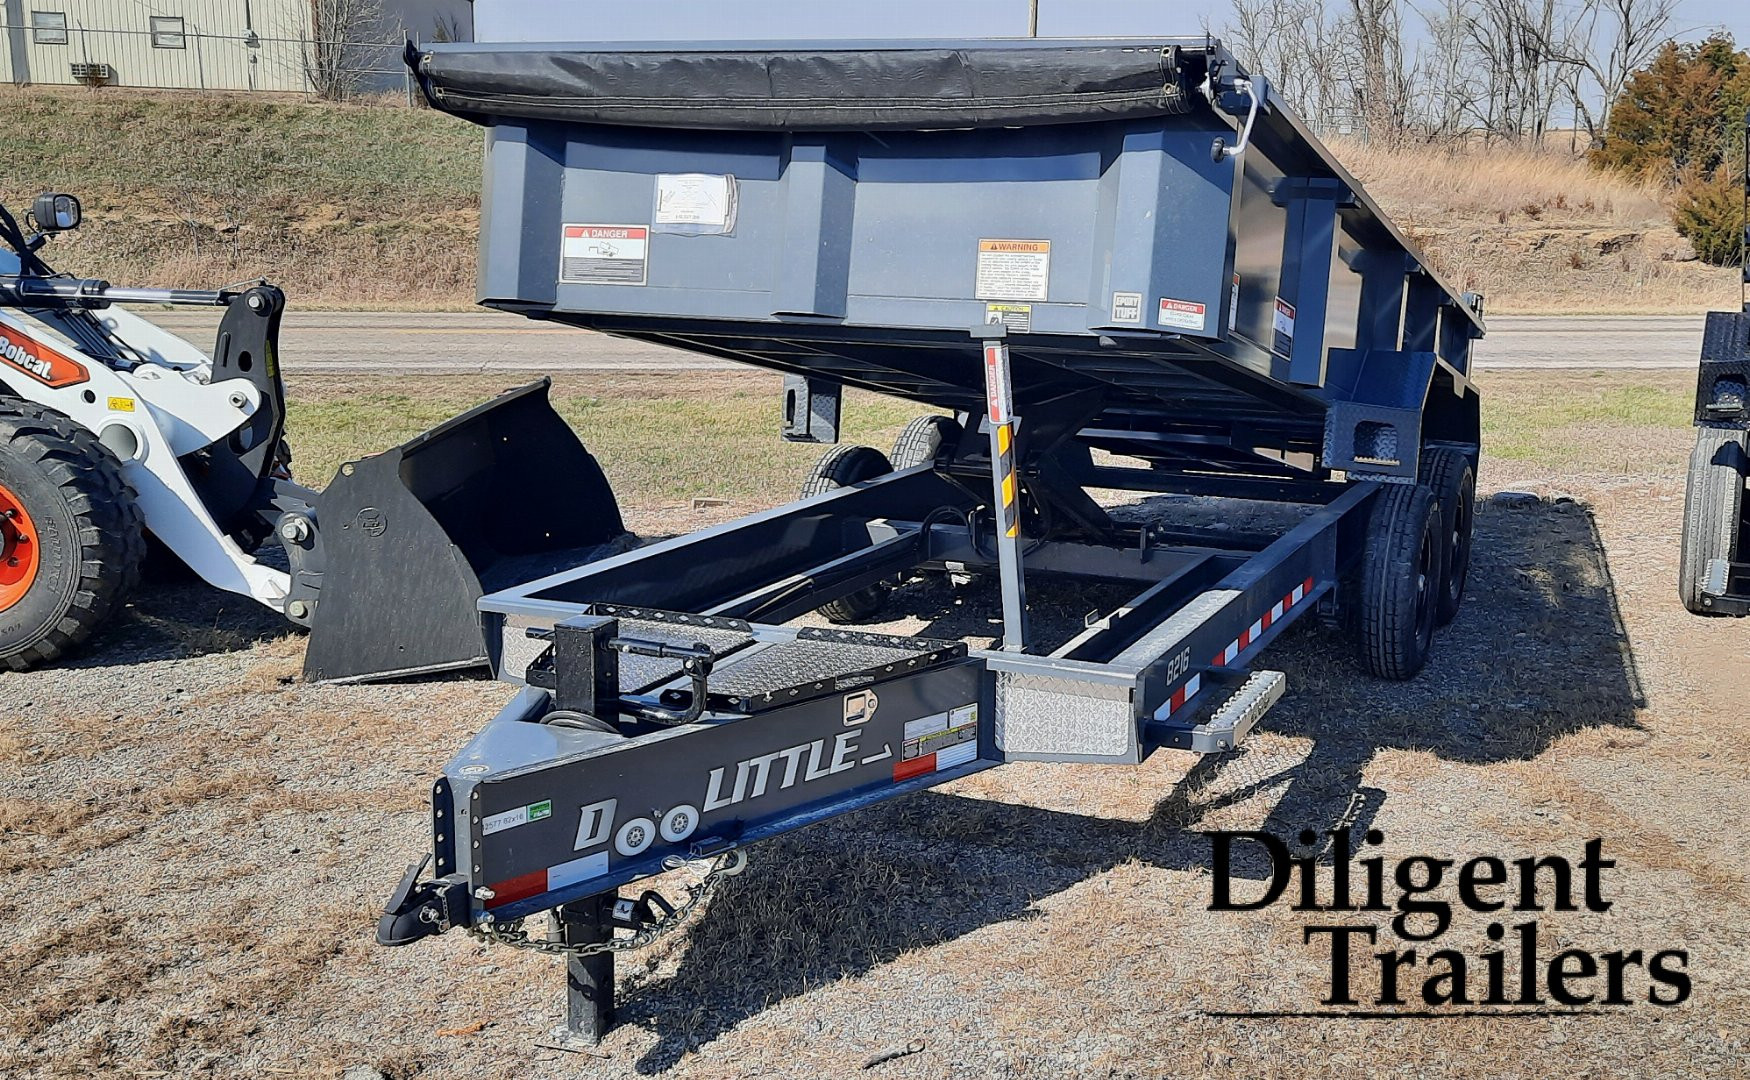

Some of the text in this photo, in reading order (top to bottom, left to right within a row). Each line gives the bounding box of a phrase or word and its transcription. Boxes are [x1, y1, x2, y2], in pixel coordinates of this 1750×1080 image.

[591, 229, 628, 239] DANGER
[998, 243, 1039, 252] WARNING
[1115, 307, 1137, 319] TUFF
[1173, 302, 1198, 313] DANGER
[0, 336, 51, 379] Bobcat
[988, 364, 998, 397] DANGER
[1166, 646, 1191, 686] 8216
